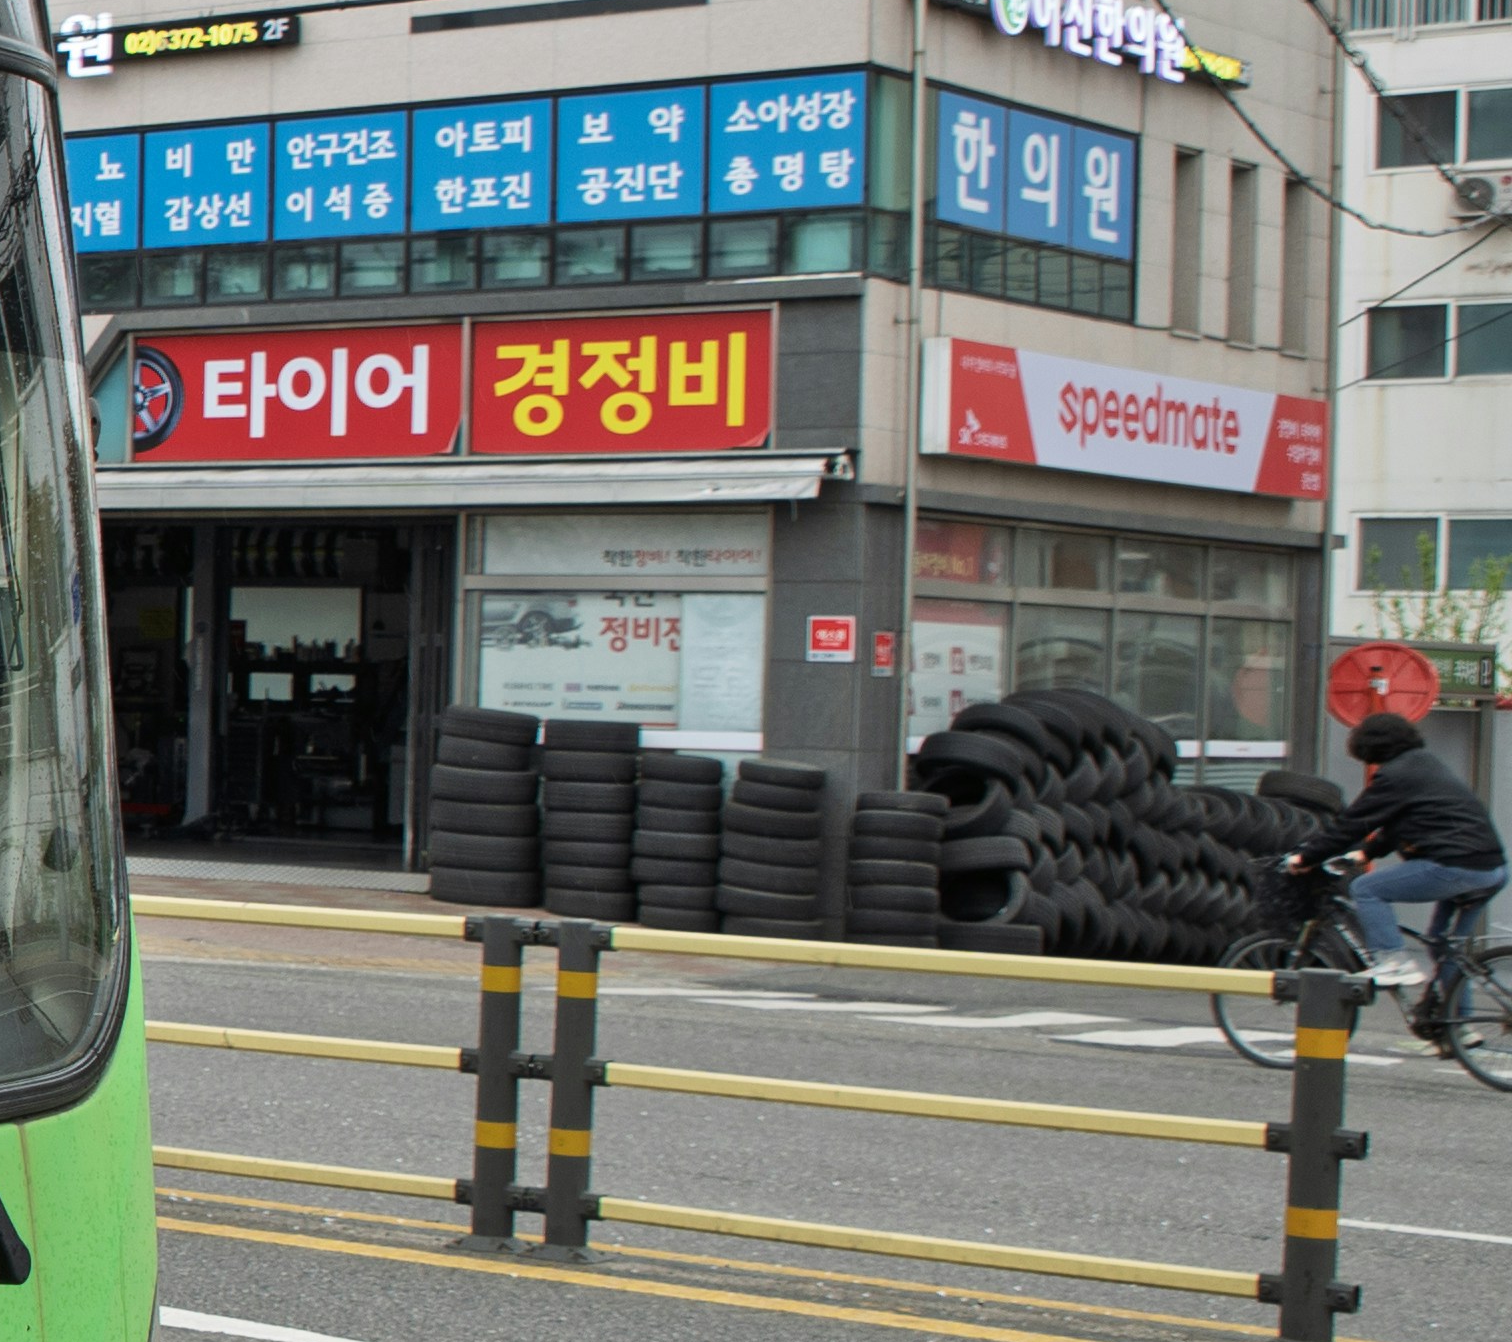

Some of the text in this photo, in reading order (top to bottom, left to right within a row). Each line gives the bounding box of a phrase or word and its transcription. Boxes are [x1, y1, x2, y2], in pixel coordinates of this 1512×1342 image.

[262, 15, 290, 42] 2F
[724, 90, 856, 135] 소아성장
[286, 126, 397, 172] 안구건조
[434, 113, 534, 159] 아토피
[434, 173, 534, 215] 한포진
[576, 163, 683, 205] 공진단
[951, 108, 1122, 245] 한의원
[163, 189, 254, 232] 갑상선
[200, 344, 432, 440] 타이어
[492, 330, 749, 439] 경정비
[1057, 380, 1240, 457] speedmate
